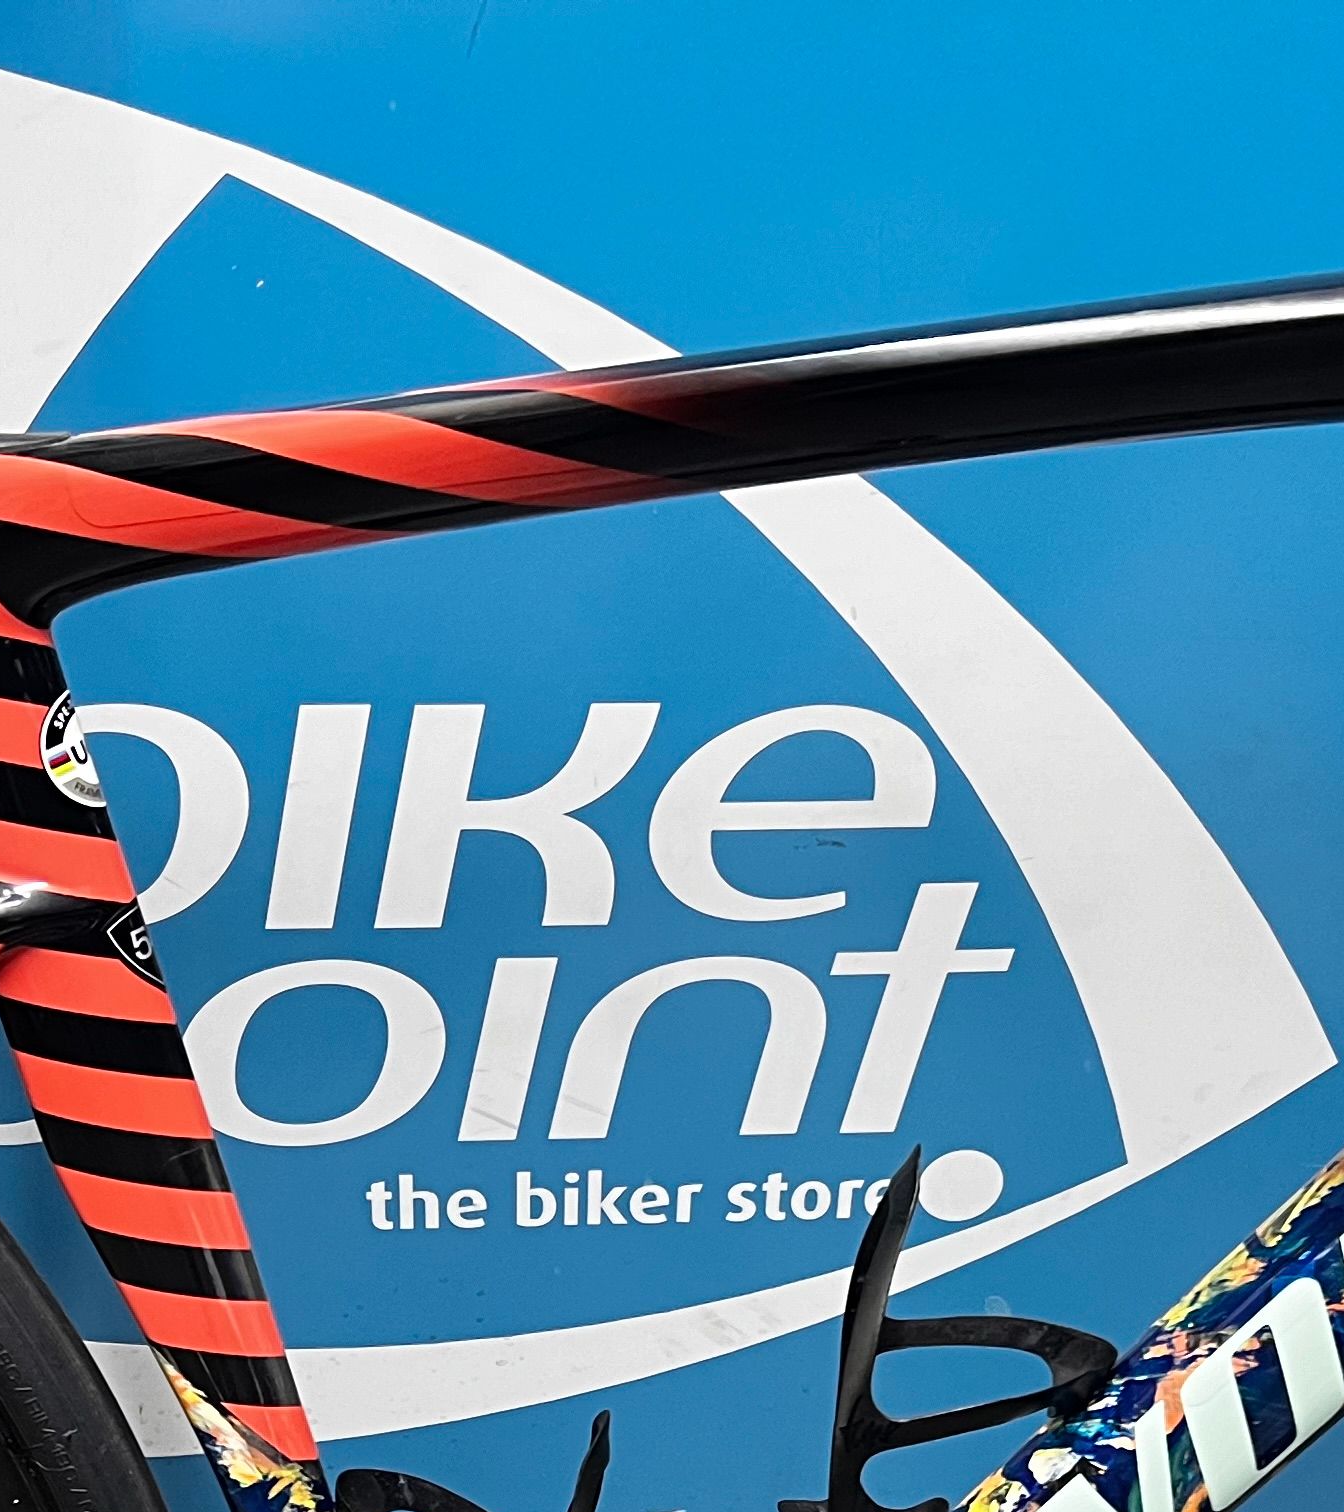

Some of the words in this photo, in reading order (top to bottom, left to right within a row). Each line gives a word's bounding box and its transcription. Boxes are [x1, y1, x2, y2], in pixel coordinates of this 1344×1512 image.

[365, 1174, 488, 1230] the
[516, 1169, 703, 1227] biker
[725, 1172, 890, 1222] store
